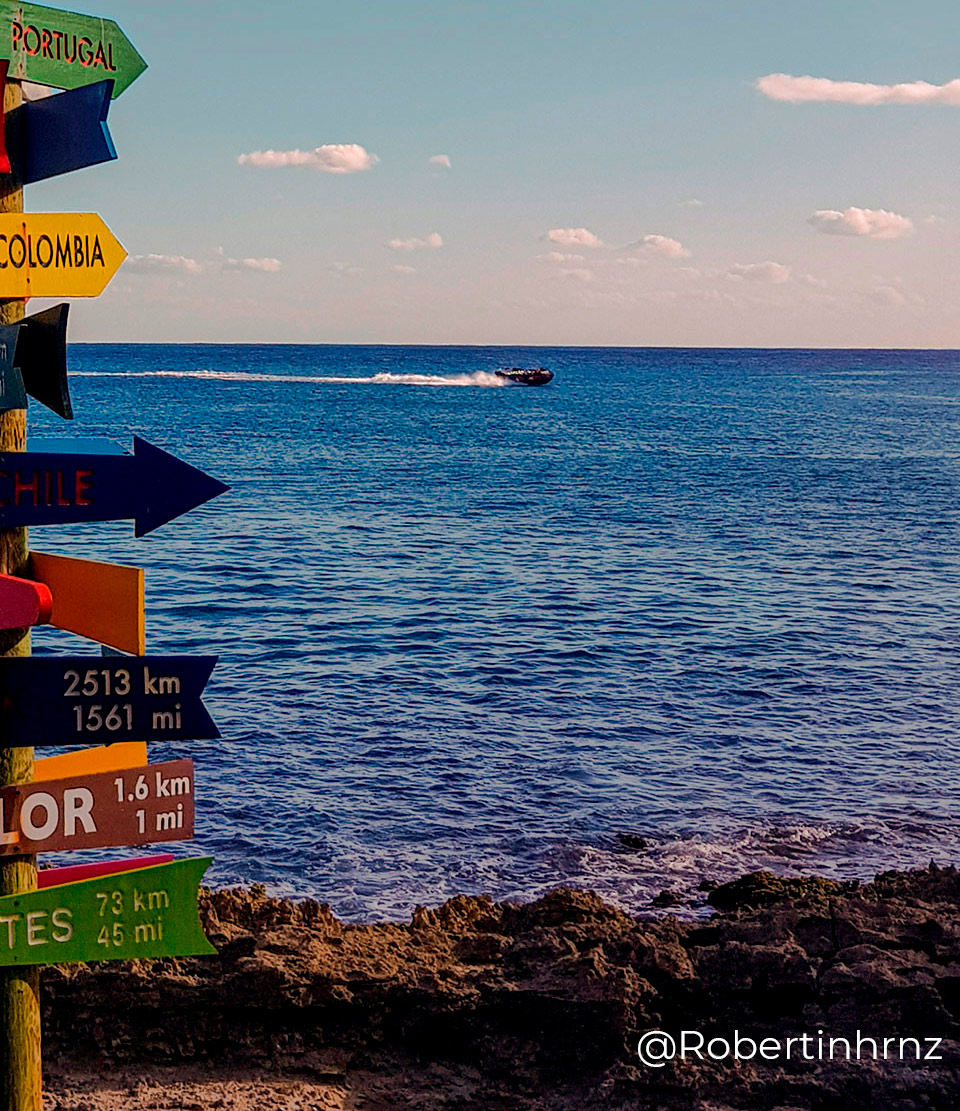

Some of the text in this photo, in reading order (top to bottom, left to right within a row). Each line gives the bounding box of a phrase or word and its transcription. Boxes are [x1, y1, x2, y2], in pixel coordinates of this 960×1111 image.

[11, 20, 116, 71] PORTUGAL
[64, 667, 180, 696] 2513 km
[73, 703, 181, 732] 1561 mi
[114, 772, 190, 803] 1.6 km
[136, 804, 183, 833] 1 mi
[97, 888, 170, 916] 73 km
[97, 917, 163, 948] 45 mi
